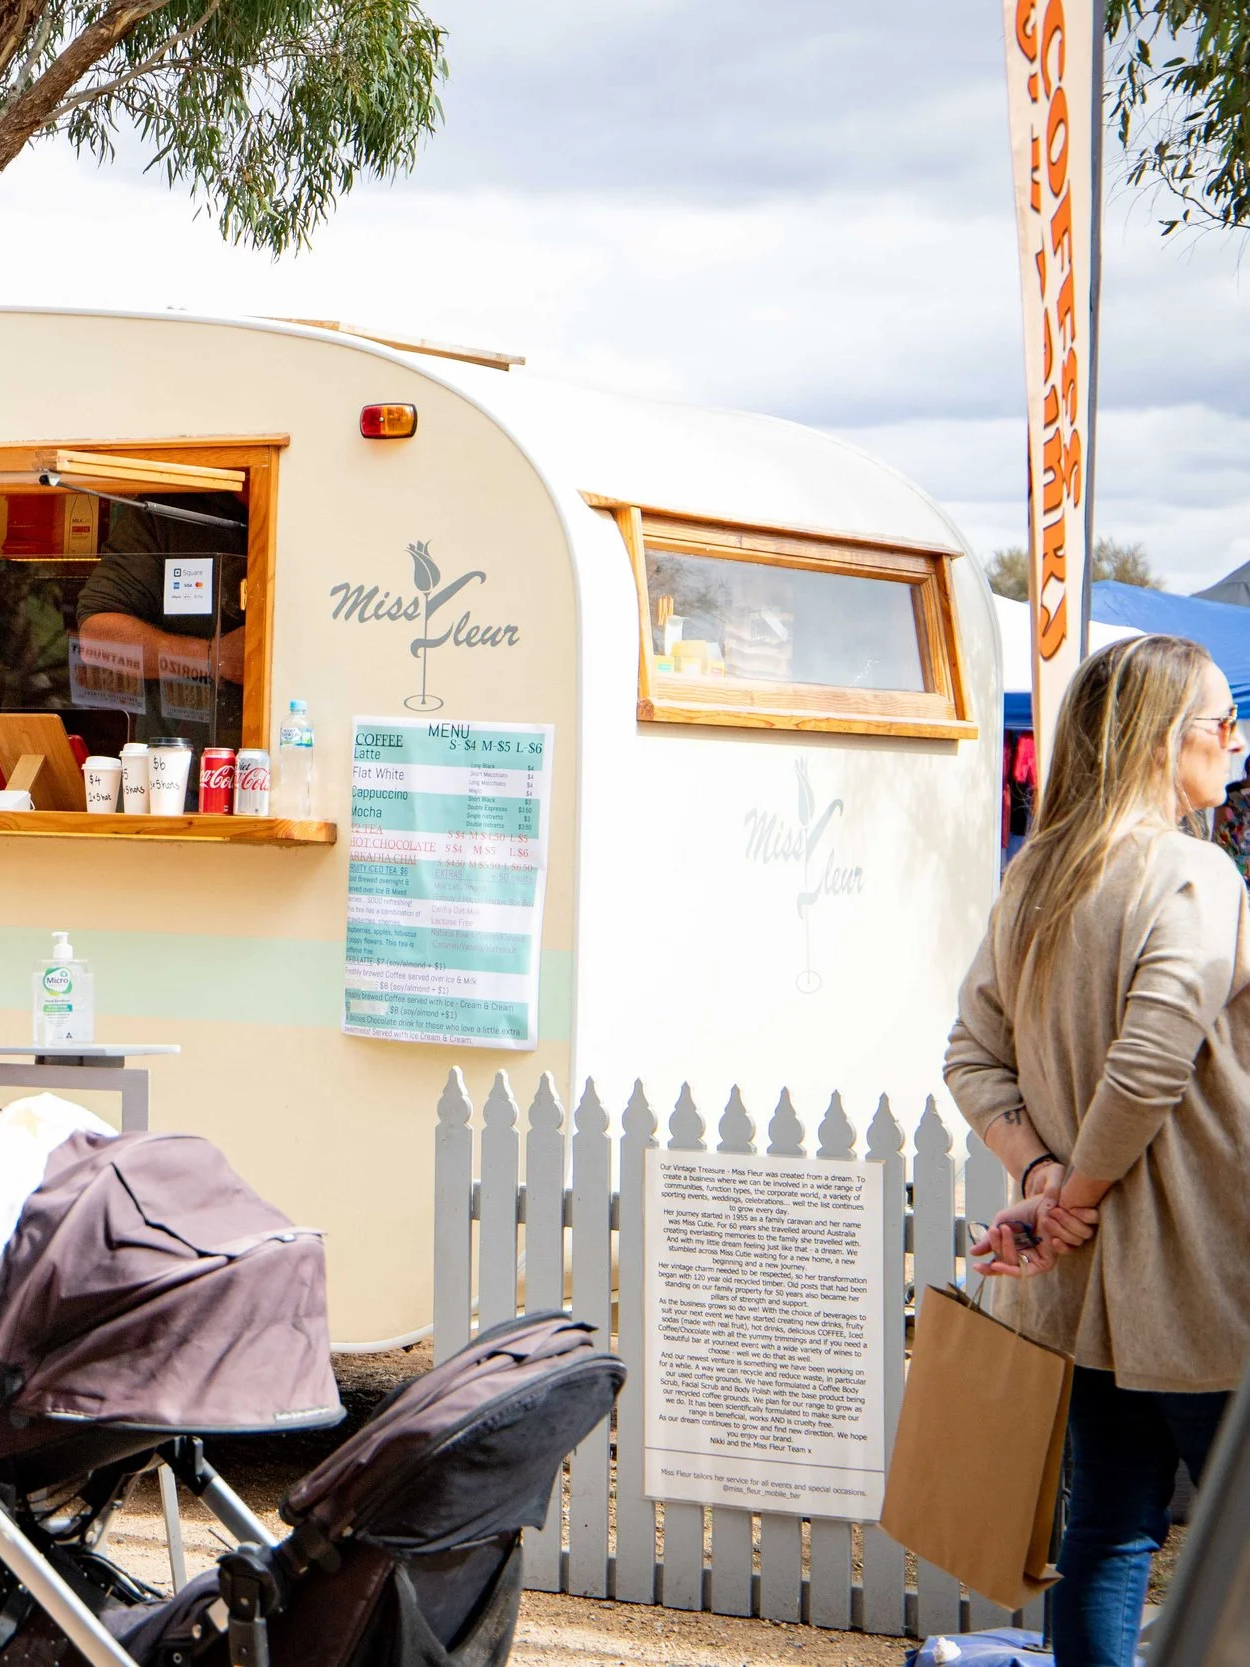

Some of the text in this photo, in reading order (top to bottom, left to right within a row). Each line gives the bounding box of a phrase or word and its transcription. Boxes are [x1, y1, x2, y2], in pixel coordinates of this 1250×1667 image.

[182, 569, 204, 577] Square
[329, 581, 421, 623] Miss
[428, 722, 470, 739] MENU
[355, 733, 403, 747] COFFEE
[464, 739, 476, 751] $4
[354, 747, 381, 760] Latte
[153, 755, 166, 771] $6
[89, 774, 101, 786] $4
[353, 766, 405, 781] Flat White
[352, 785, 408, 801] Cappuccino
[352, 805, 382, 818] Mocha
[364, 824, 382, 834] TEA
[743, 807, 805, 865] Miss
[373, 838, 436, 852] CHOCOLATE
[393, 854, 417, 864] CHAI
[369, 865, 383, 873] ICED
[367, 1016, 396, 1026] Chocolate
[398, 1019, 414, 1027] drink
[416, 1020, 424, 1028] for
[426, 1020, 443, 1029] those
[446, 1023, 459, 1031] who
[461, 1024, 474, 1032] love
[483, 1026, 500, 1034] little
[372, 1028, 392, 1037] Served
[420, 1033, 440, 1041] Cream
[672, 1164, 696, 1173] Vintage
[698, 1166, 725, 1174] Treasure
[779, 1171, 804, 1179] created
[661, 1190, 685, 1200] sporting
[831, 1202, 864, 1210] continues
[706, 1184, 731, 1192] function
[766, 1188, 798, 1198] corporate
[828, 1192, 851, 1202] variety
[771, 1225, 799, 1233] travelled
[801, 1227, 825, 1235] around
[826, 1229, 855, 1237] Australia
[661, 1315, 679, 1323] sodas
[680, 1317, 701, 1326] (made
[787, 1326, 816, 1335] delicious
[848, 1331, 863, 1339] Iced
[739, 1431, 758, 1440] enjoy
[710, 1437, 725, 1445] Nikki
[726, 1438, 739, 1446] and
[753, 1441, 767, 1449] Miss
[769, 1443, 785, 1451] Fleur
[787, 1444, 805, 1453] Team
[661, 1468, 674, 1476] Miss
[675, 1470, 691, 1478] Fleur
[693, 1472, 712, 1480] tailors
[726, 1475, 748, 1484] service
[749, 1477, 759, 1485] for
[770, 1480, 792, 1488] events
[793, 1482, 806, 1490] and
[808, 1484, 831, 1494] special
